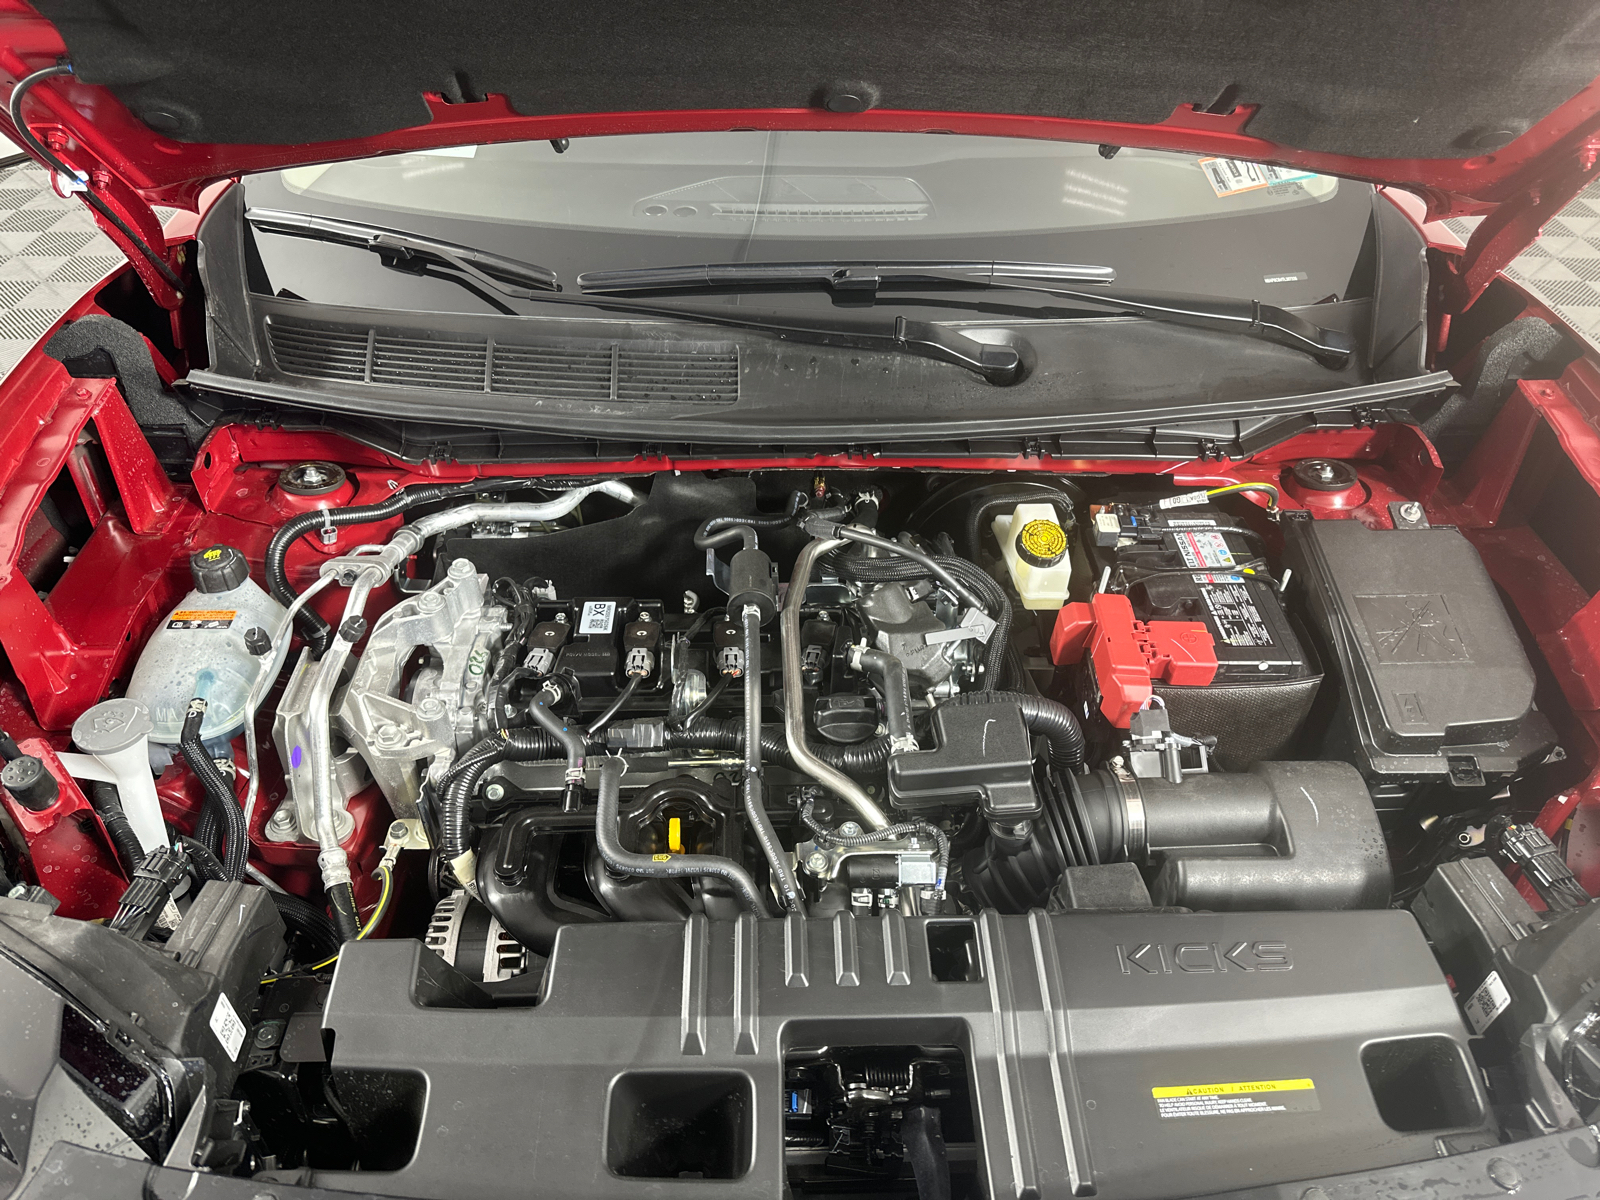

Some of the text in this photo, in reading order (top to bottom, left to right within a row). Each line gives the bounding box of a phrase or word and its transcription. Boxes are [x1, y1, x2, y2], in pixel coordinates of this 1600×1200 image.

[592, 604, 606, 616] BX
[156, 706, 186, 722] MA
[1116, 941, 1294, 975] KICKS
[1192, 1087, 1224, 1095] CAUTION
[1239, 1084, 1277, 1092] ATTENTION
